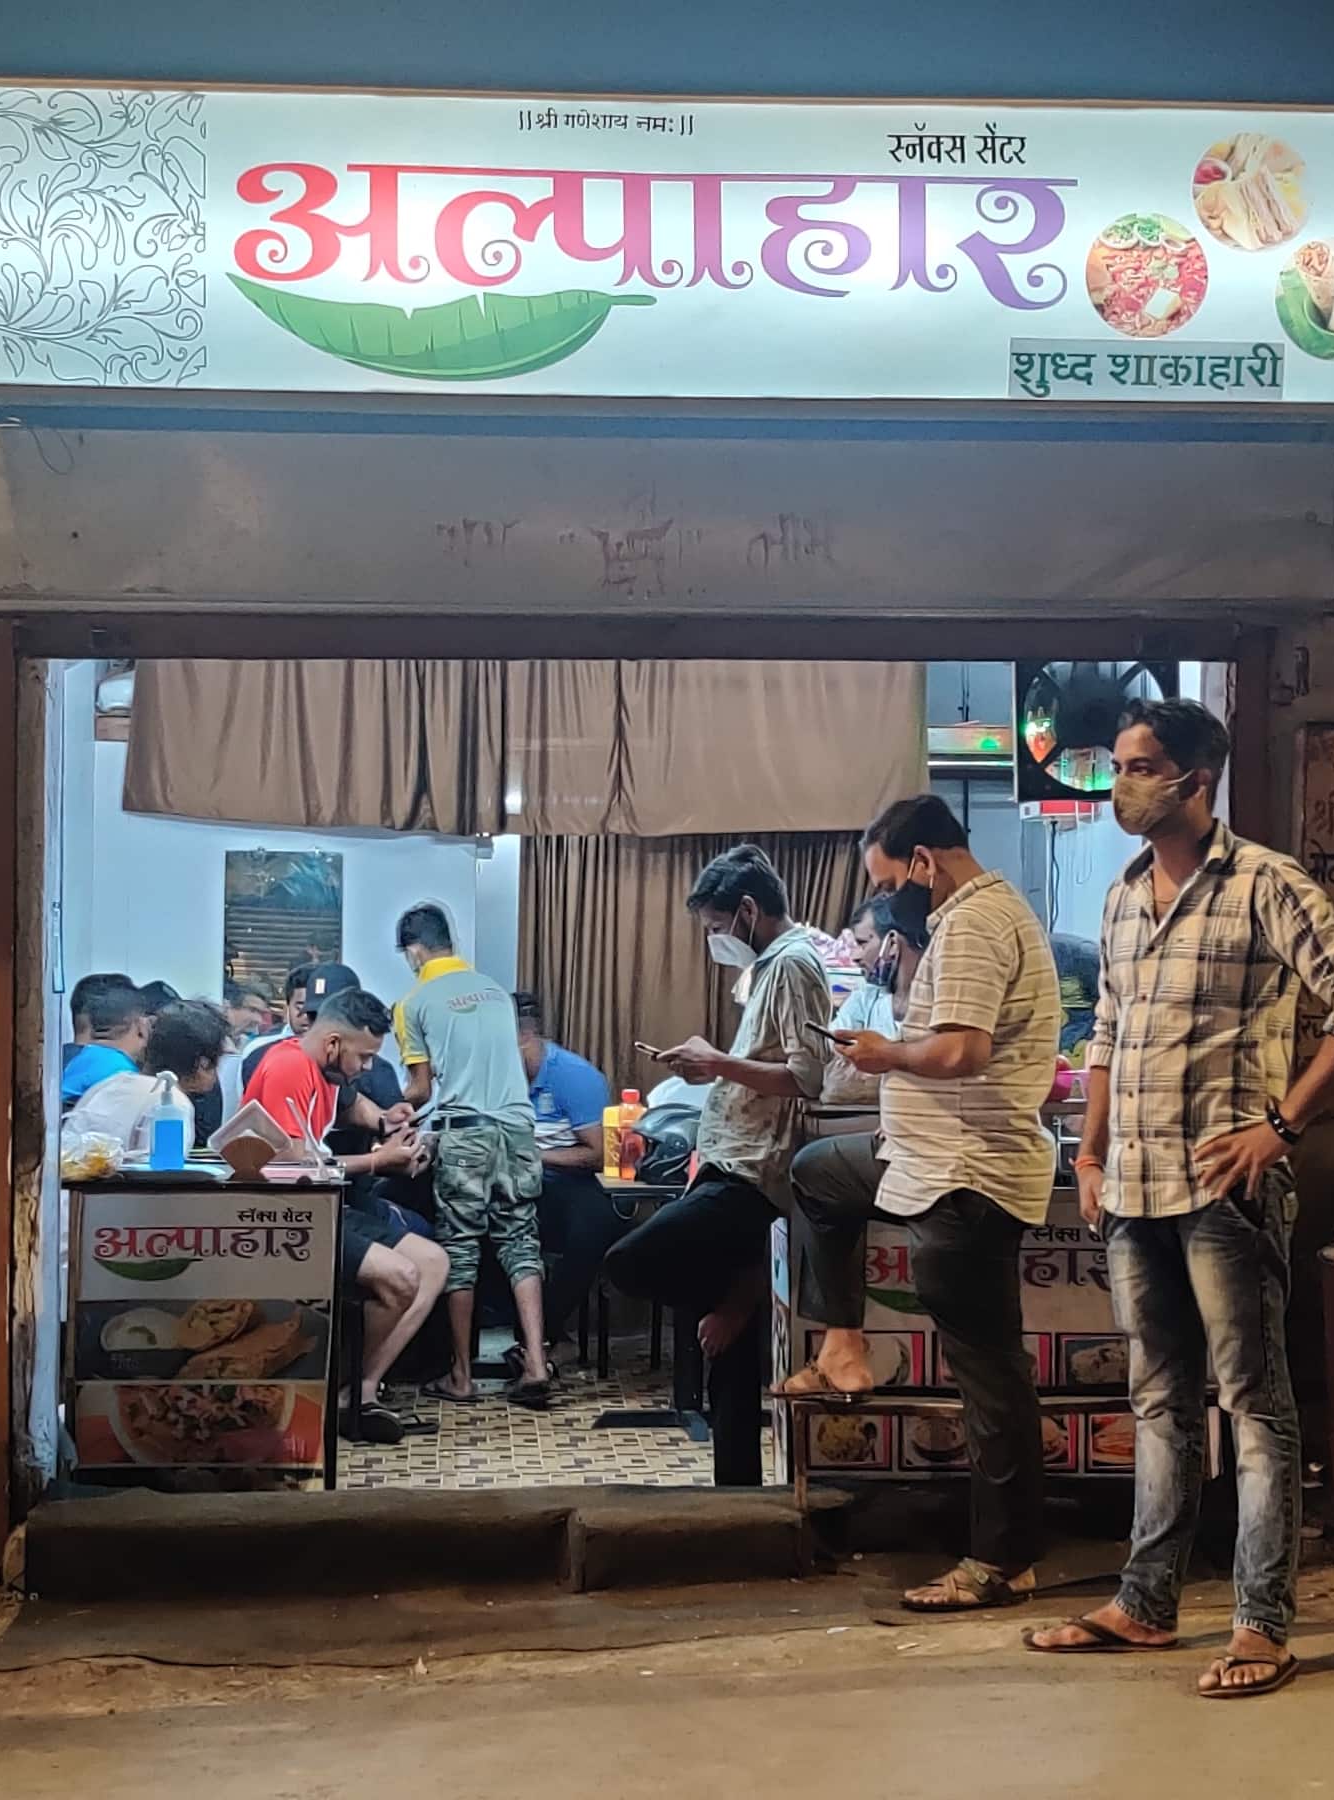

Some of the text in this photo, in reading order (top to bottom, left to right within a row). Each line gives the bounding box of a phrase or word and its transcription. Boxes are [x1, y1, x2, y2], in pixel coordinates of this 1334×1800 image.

[563, 108, 629, 131] गणेशाय
[888, 122, 1028, 166] स्नॅक्स सेंटर
[233, 162, 1079, 311] अल्पाहार
[1108, 343, 1284, 390] शाकाहारी
[93, 1226, 315, 1262] अल्पाहार
